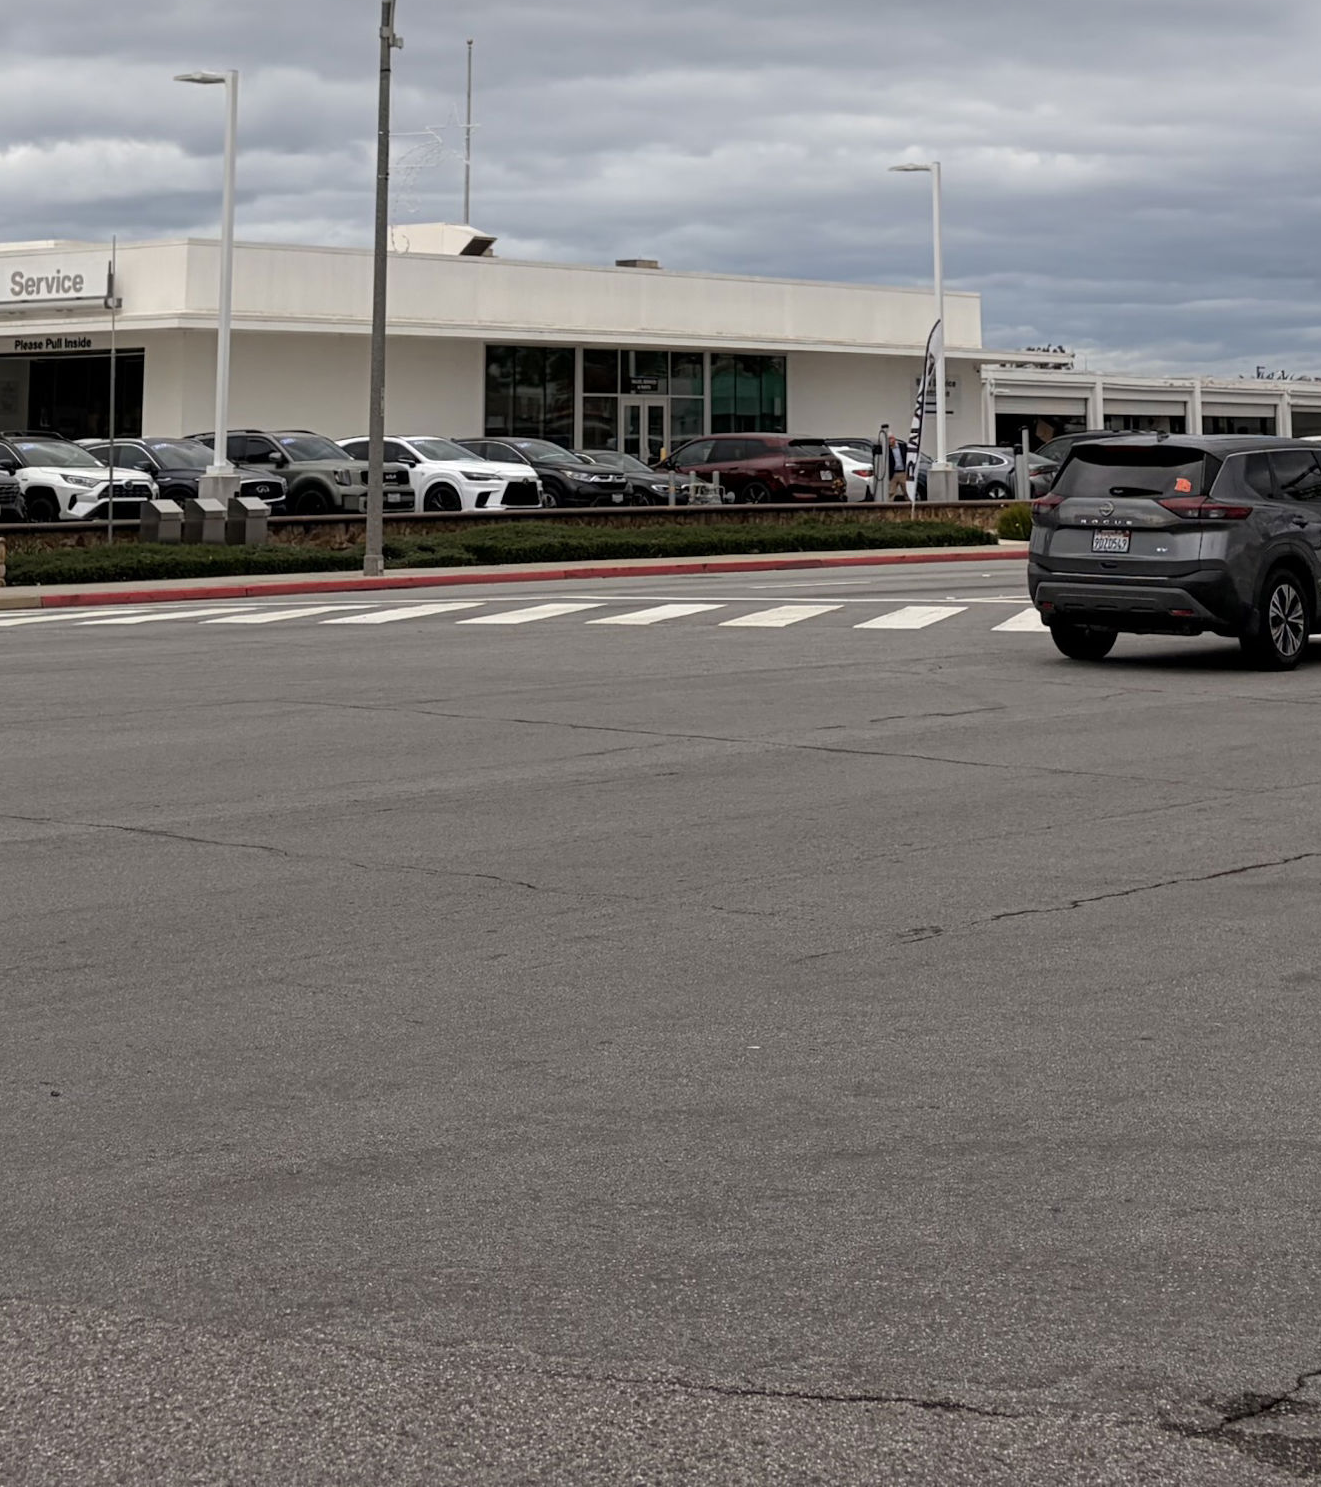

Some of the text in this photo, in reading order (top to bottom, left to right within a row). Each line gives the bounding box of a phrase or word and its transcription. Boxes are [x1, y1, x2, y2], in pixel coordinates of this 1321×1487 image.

[10, 269, 85, 297] Service
[14, 336, 92, 351] Please Pull Inside
